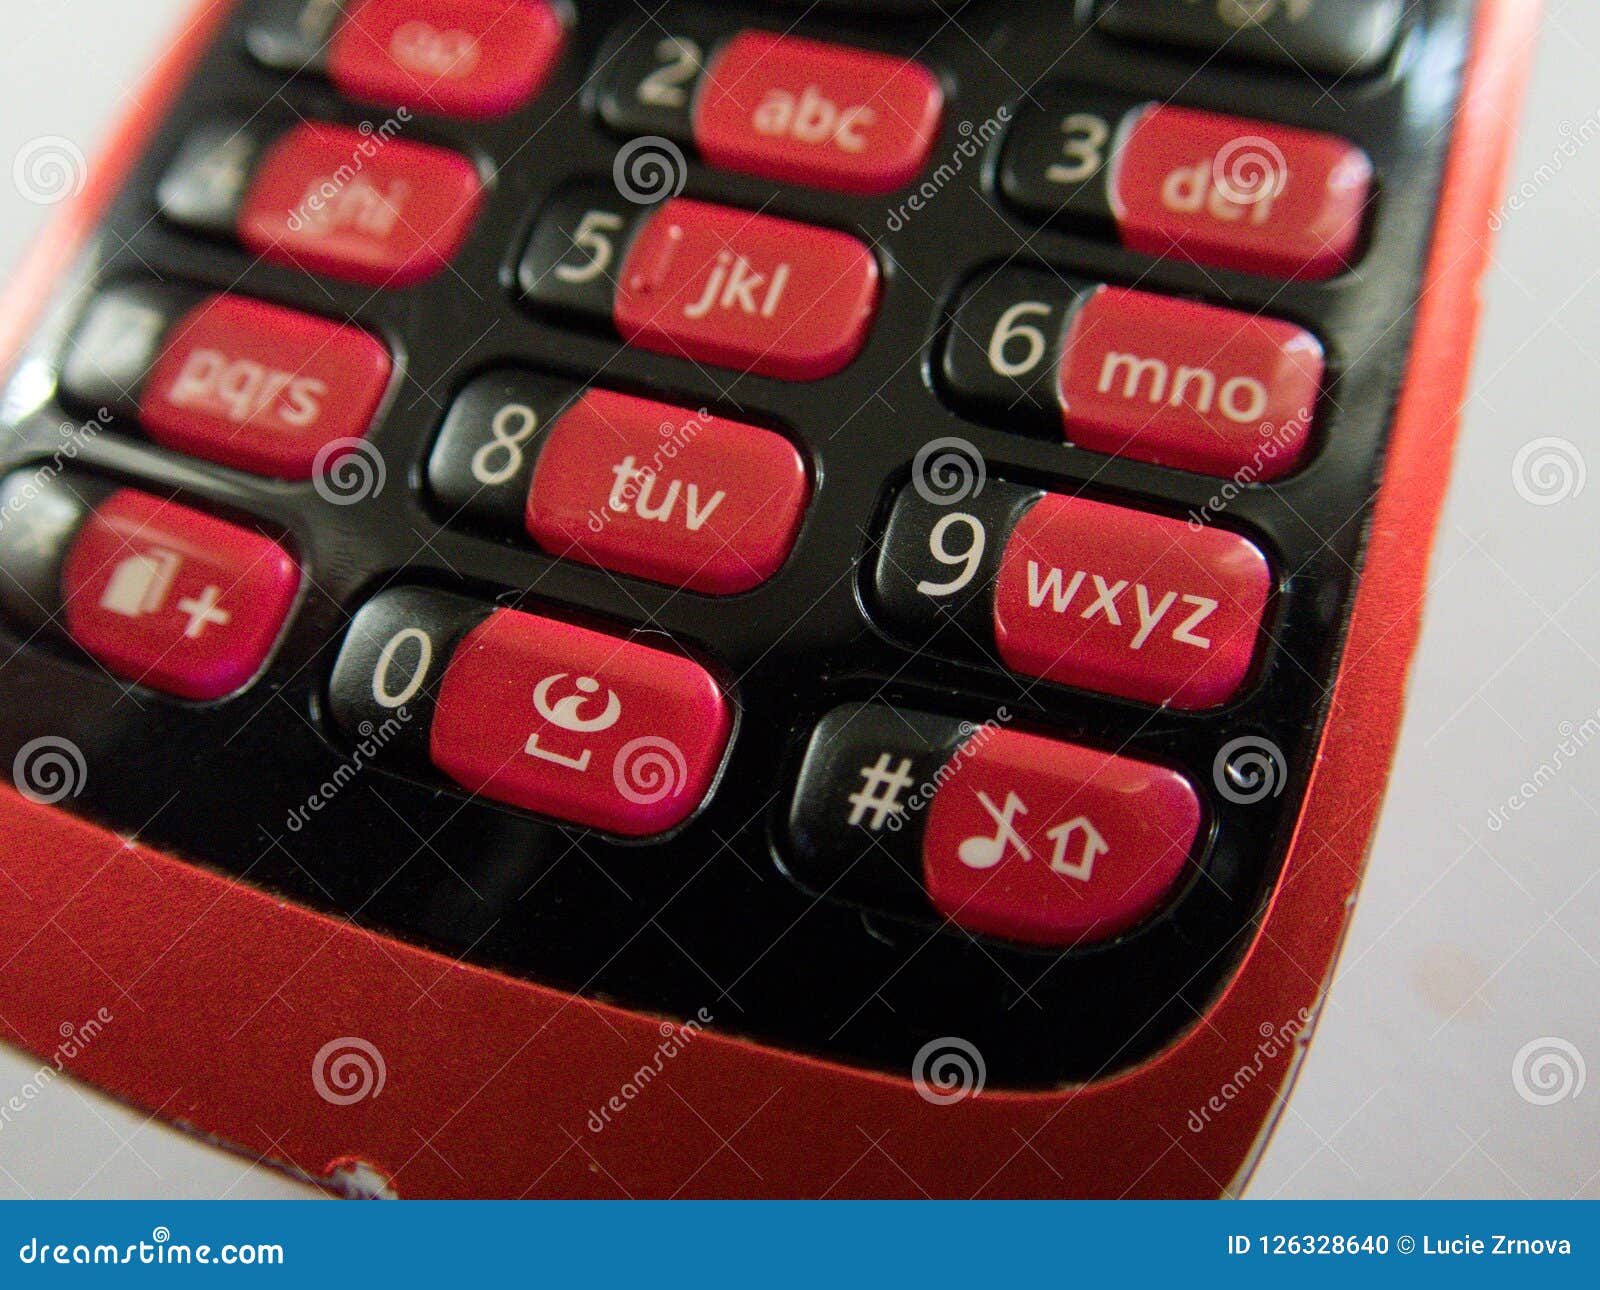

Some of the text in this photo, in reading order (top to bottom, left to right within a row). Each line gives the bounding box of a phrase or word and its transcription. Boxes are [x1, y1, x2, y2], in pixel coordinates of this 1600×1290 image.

[638, 36, 876, 152] 2 abc
[1045, 113, 1110, 183] 3
[554, 211, 790, 319] 5 jkl
[168, 347, 328, 427] pqrs
[988, 301, 1268, 422] 6 mno
[471, 404, 726, 531] 8 tuv
[917, 512, 1218, 649] 9 wxyz
[373, 627, 432, 708] 0
[848, 753, 914, 830] #
